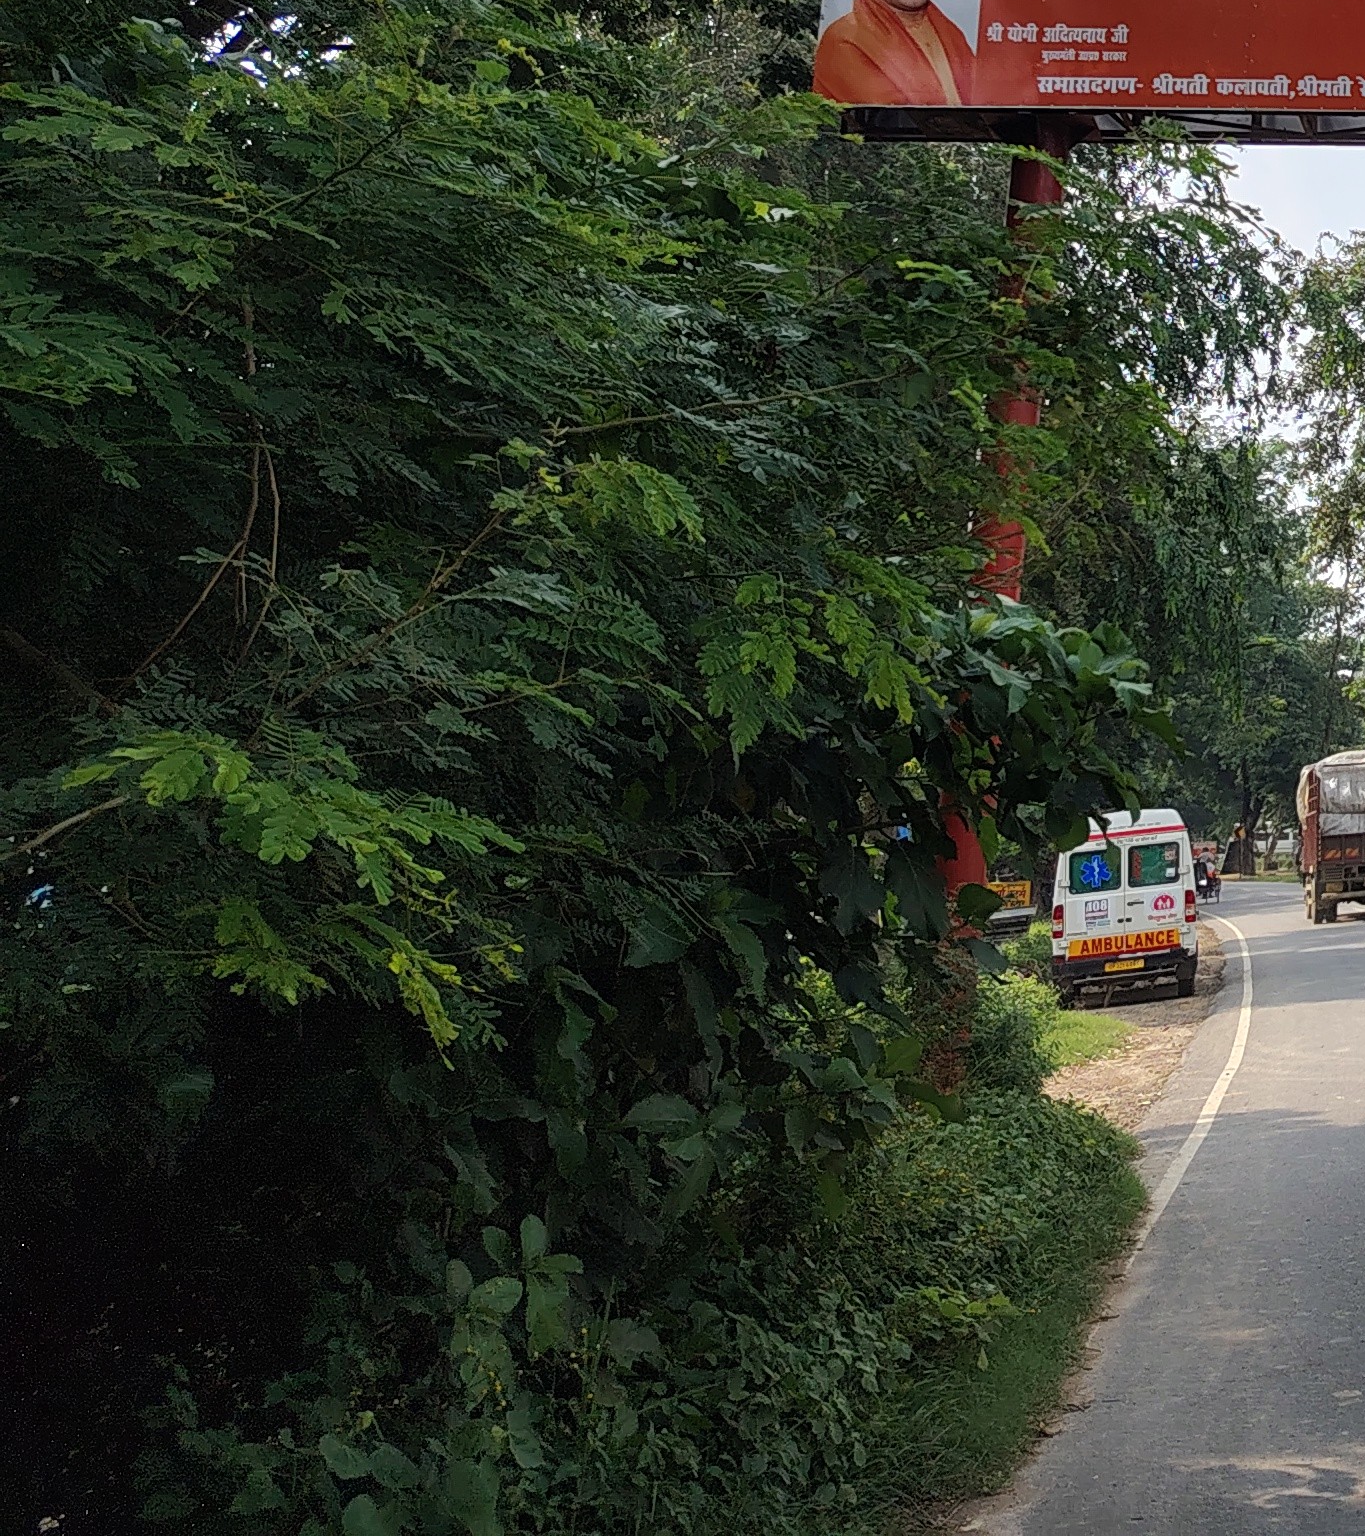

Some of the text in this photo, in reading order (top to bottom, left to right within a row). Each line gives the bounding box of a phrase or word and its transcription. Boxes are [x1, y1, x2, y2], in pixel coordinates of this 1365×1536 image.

[1008, 22, 1038, 43] योगी
[1111, 24, 1129, 45] जी
[1152, 73, 1210, 95] श्रीमती
[1080, 929, 1175, 954] AMBULANCE
